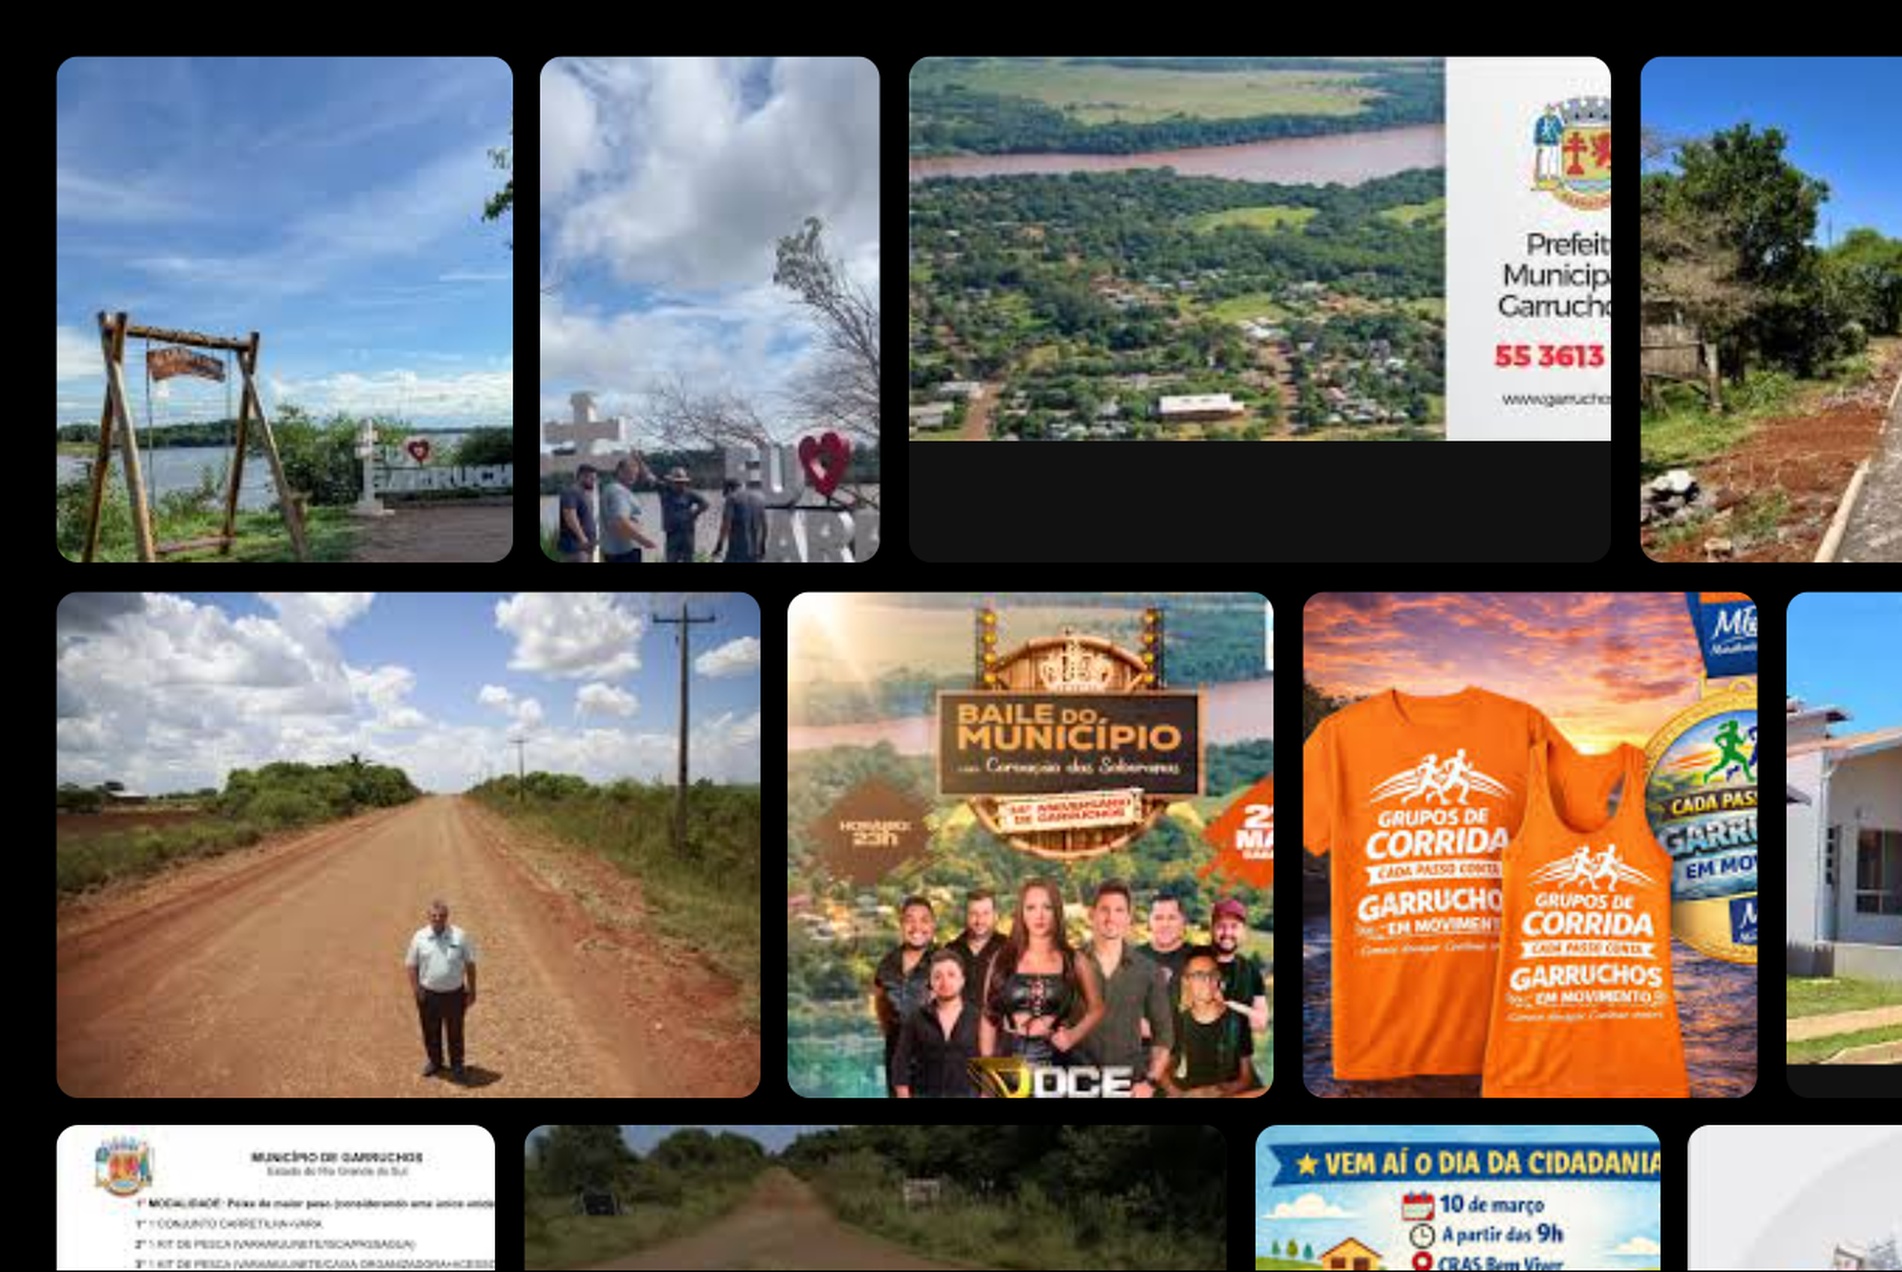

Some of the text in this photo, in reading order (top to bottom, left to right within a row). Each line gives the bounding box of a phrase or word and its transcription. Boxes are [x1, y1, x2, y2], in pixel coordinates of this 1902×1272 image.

[1504, 263, 1611, 292] Municip
[1494, 344, 1605, 368] 55 3613
[958, 703, 1097, 724] BAILE DO
[958, 717, 1182, 751] MUNICÍPIO
[1672, 790, 1758, 816] CADA PAS
[1378, 807, 1490, 828] GRUPOS DE
[1366, 827, 1509, 860] CORRIDA
[1686, 861, 1715, 880] EM
[1535, 892, 1635, 909] GRUPOS DE
[1521, 911, 1654, 937] CORRIDA
[1510, 963, 1663, 991] GARRUCHOS
[1561, 990, 1652, 1005] MOVIMENTO
[1325, 1151, 1376, 1175] VEM
[1382, 1147, 1409, 1174] AÍ
[1439, 1151, 1480, 1175] DIA
[1488, 1151, 1522, 1174] DA
[1440, 1195, 1545, 1217] 10 de março
[1443, 1223, 1563, 1246] A partir das 9h
[1438, 1256, 1482, 1271] CRAS
